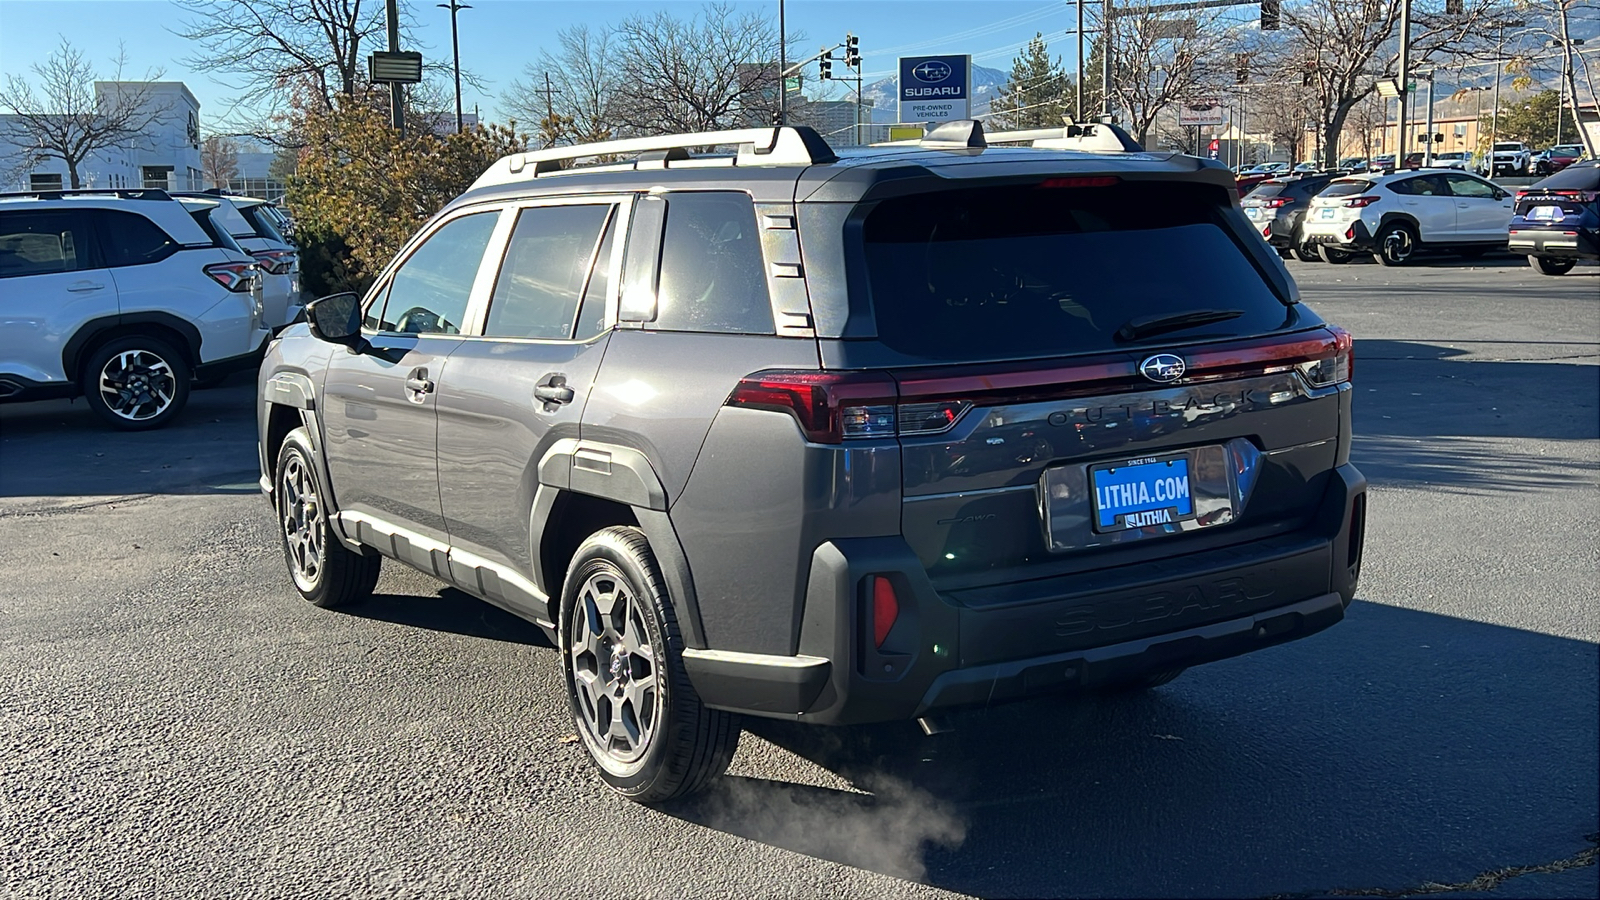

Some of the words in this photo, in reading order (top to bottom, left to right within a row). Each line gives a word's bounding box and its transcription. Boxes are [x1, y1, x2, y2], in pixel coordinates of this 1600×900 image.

[905, 86, 960, 96] SUBARU
[1047, 388, 1256, 428] OUTBACK
[1096, 476, 1190, 510] LITHIA.COM
[1135, 509, 1172, 526] LITHIA
[1055, 568, 1278, 637] SUBARU
